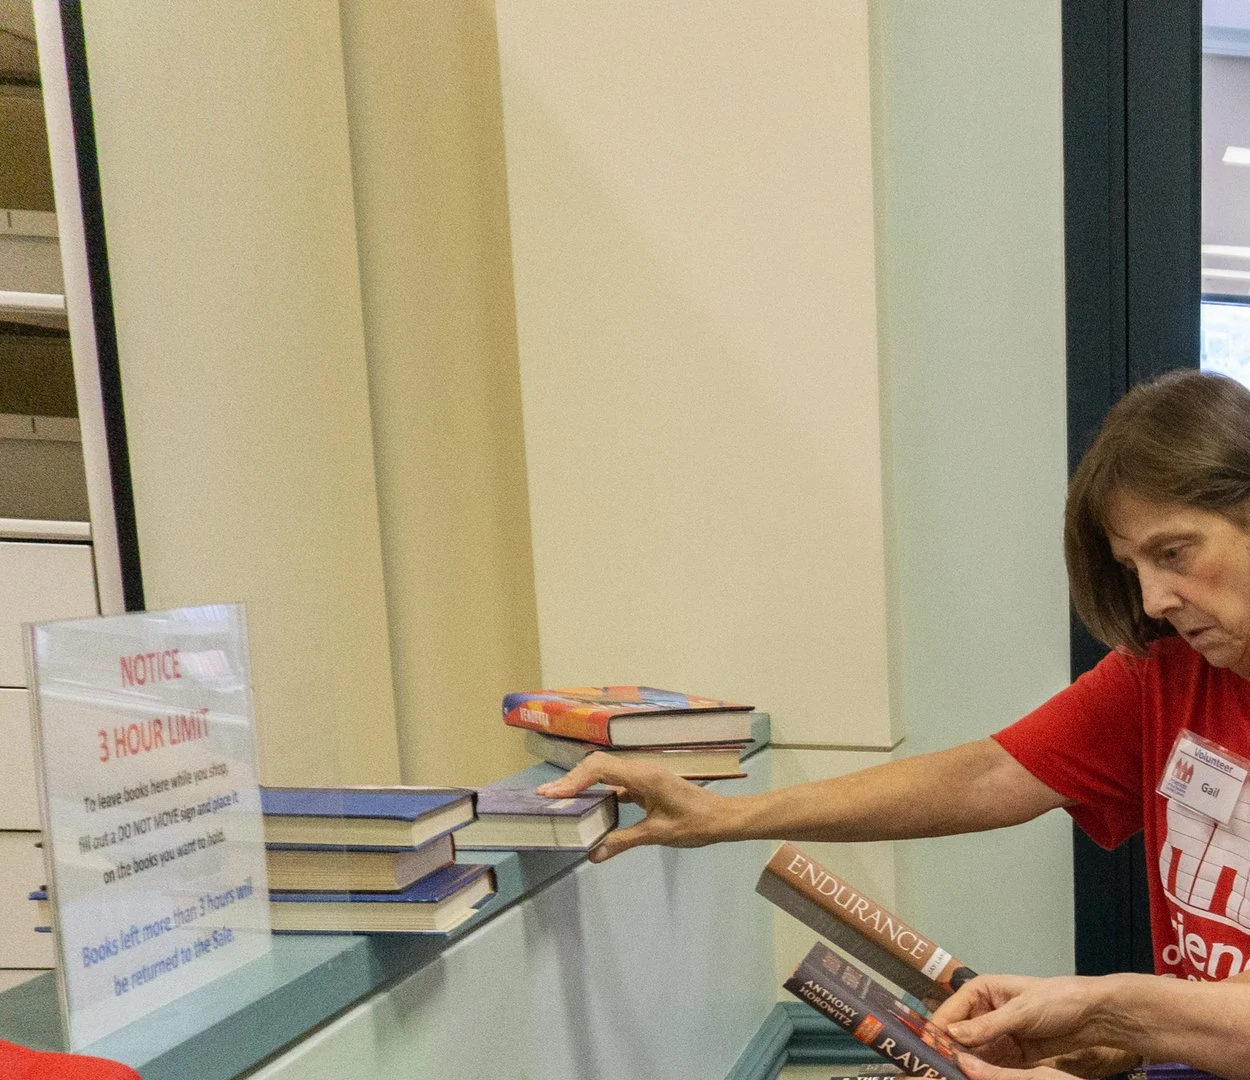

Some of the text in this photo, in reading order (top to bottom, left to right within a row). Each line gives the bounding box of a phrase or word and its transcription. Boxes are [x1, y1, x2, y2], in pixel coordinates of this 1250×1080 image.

[119, 648, 183, 688] NOTICE
[98, 707, 210, 763] 3 HOUR LIMIT
[1194, 747, 1235, 774] Volunteer
[84, 797, 96, 813] To
[97, 792, 122, 811] leave
[123, 783, 150, 803] books
[150, 778, 170, 796] here
[170, 770, 193, 789] while
[193, 768, 208, 786] you
[1201, 782, 1220, 799] Gail
[79, 834, 92, 853] fill
[93, 831, 109, 850] out
[111, 832, 116, 845] a
[118, 823, 132, 842] DO
[134, 816, 153, 836] NOT
[153, 808, 180, 830] MOVE
[180, 804, 197, 823] sign
[197, 797, 212, 816] and
[212, 794, 233, 814] place
[103, 869, 115, 885] on
[117, 861, 132, 881] the
[133, 851, 159, 874] books
[160, 848, 175, 867] you
[176, 839, 198, 858] want
[198, 835, 207, 850] to
[82, 876, 253, 968] Books left more than 3 hours will
[786, 853, 929, 960] ENDURANCE
[114, 974, 129, 997] be
[131, 947, 180, 989] returned
[181, 946, 193, 965] to
[193, 936, 212, 959] the
[799, 985, 853, 1027] HOROWITZ
[804, 979, 858, 1018] ANTHONY
